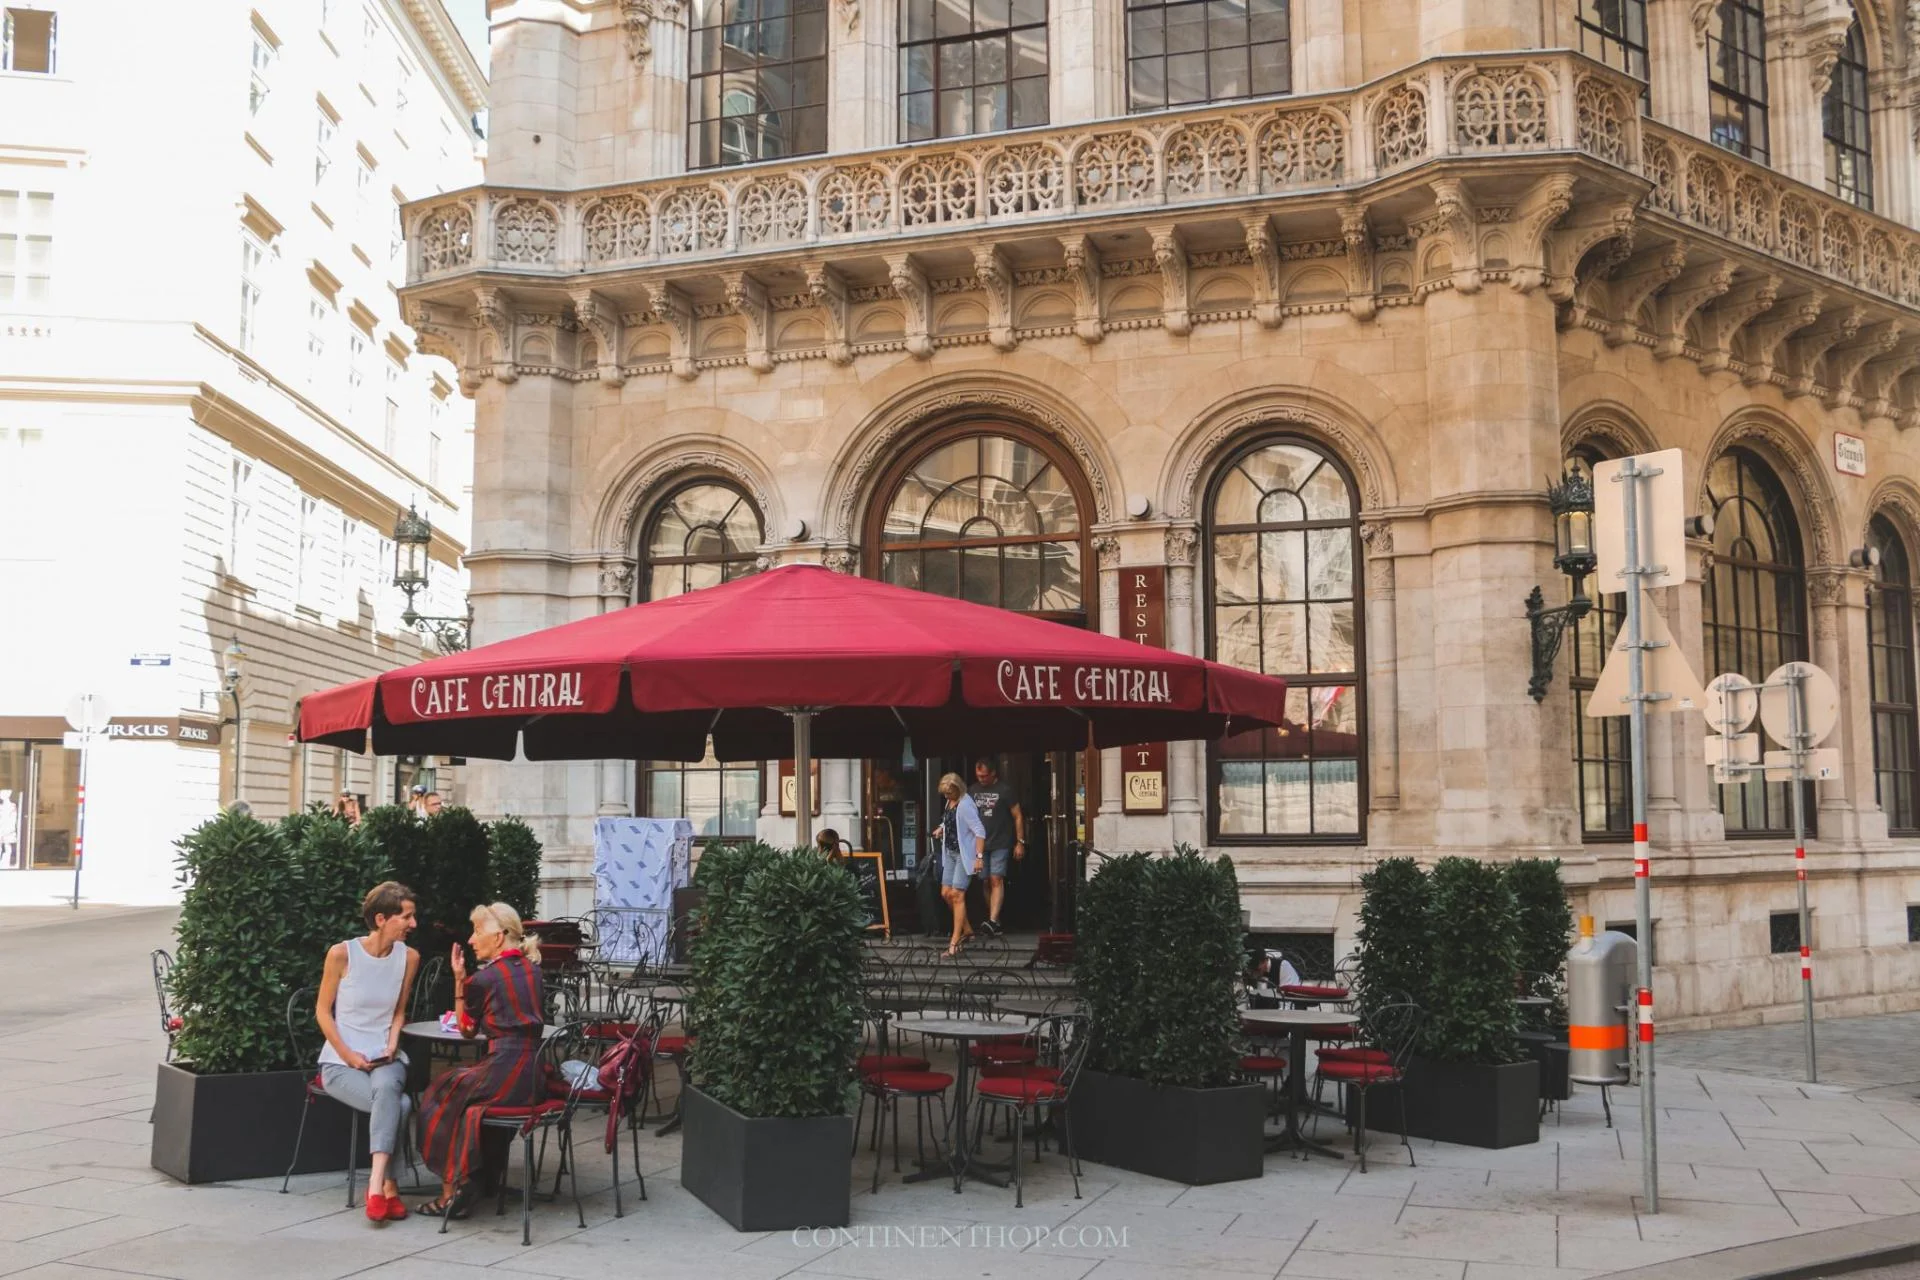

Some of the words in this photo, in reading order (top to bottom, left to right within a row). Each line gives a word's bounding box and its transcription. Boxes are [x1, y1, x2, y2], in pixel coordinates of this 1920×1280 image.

[997, 659, 1062, 704] CAFE
[1074, 667, 1172, 703] CENTRAL
[410, 677, 469, 719] CAFE
[482, 672, 584, 709] CENTRAL
[105, 724, 169, 736] IRKUS
[179, 726, 208, 740] ZIRKUS
[1129, 775, 1158, 801] CAFE
